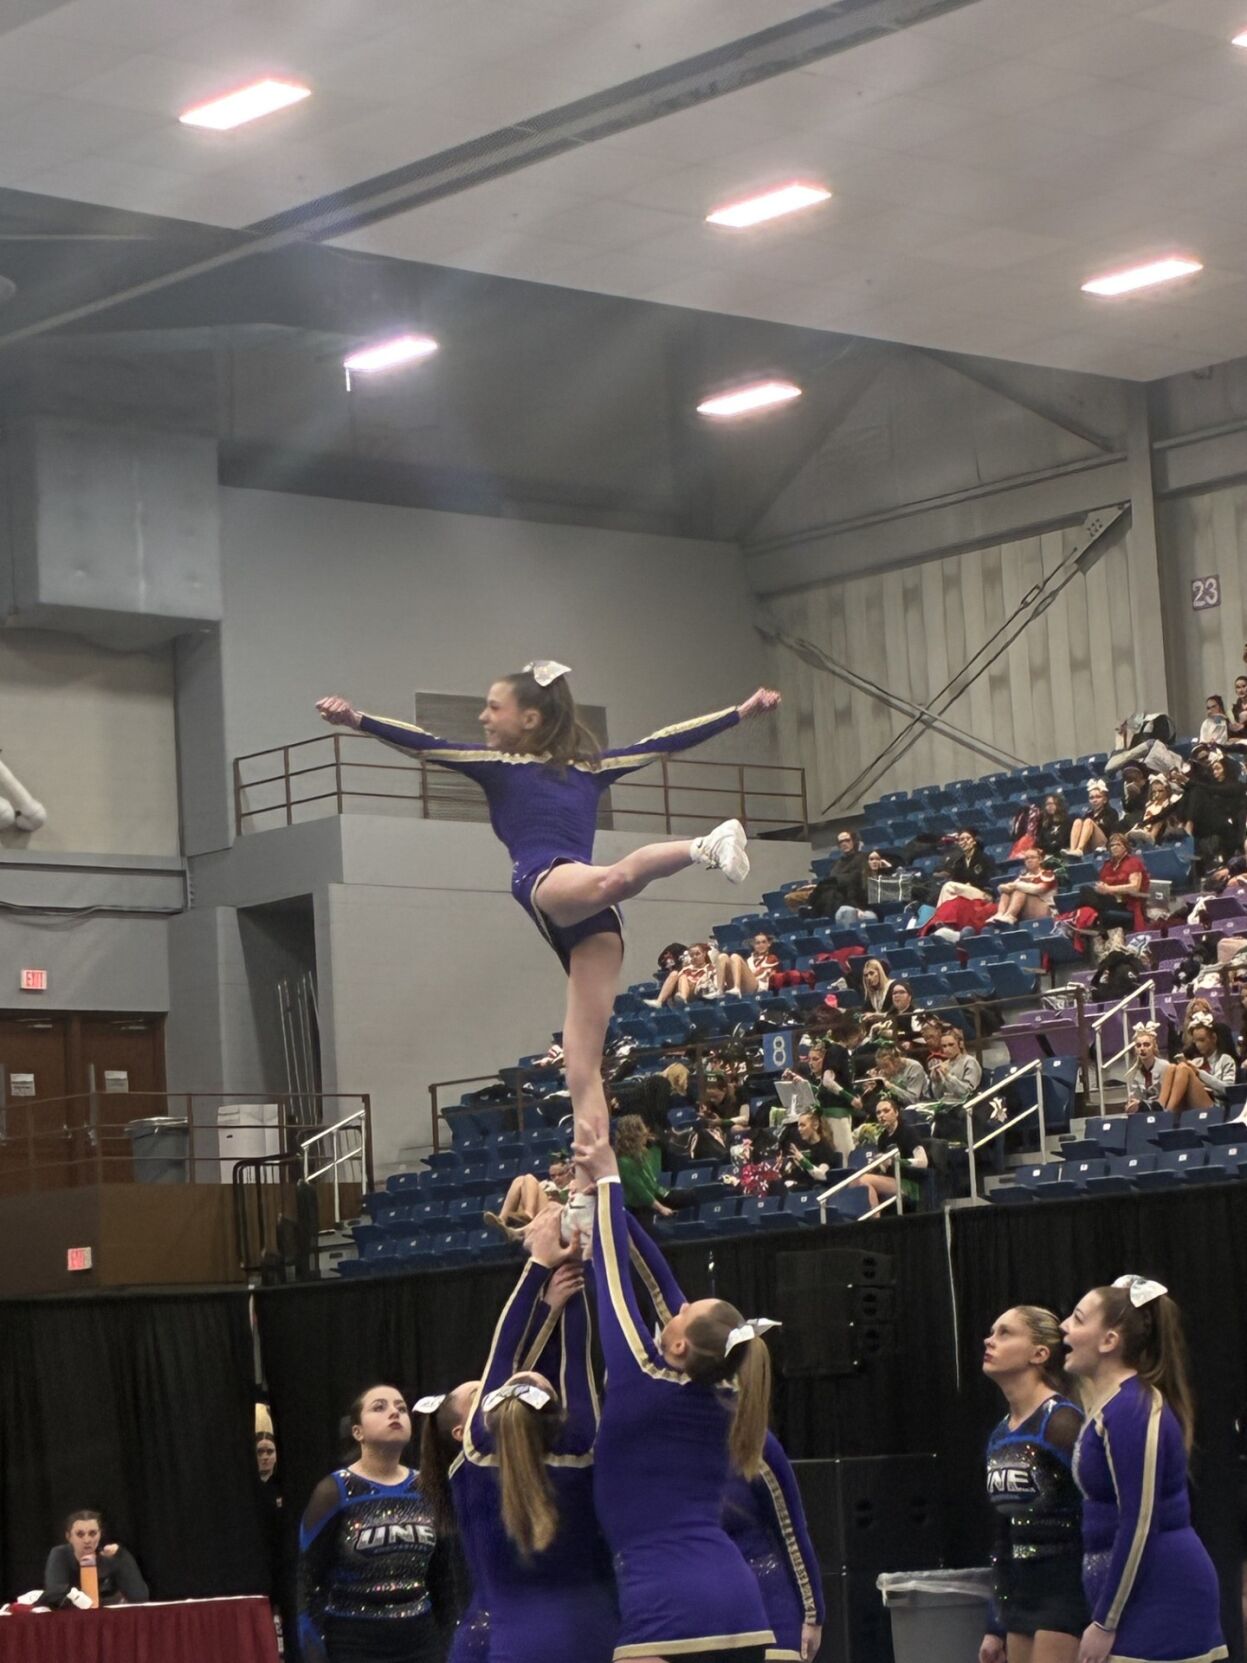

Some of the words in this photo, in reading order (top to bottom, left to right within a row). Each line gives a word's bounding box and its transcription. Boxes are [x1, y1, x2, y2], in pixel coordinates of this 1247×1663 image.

[1192, 578, 1218, 607] 23
[773, 1035, 786, 1067] 8
[356, 1524, 436, 1550] UNE
